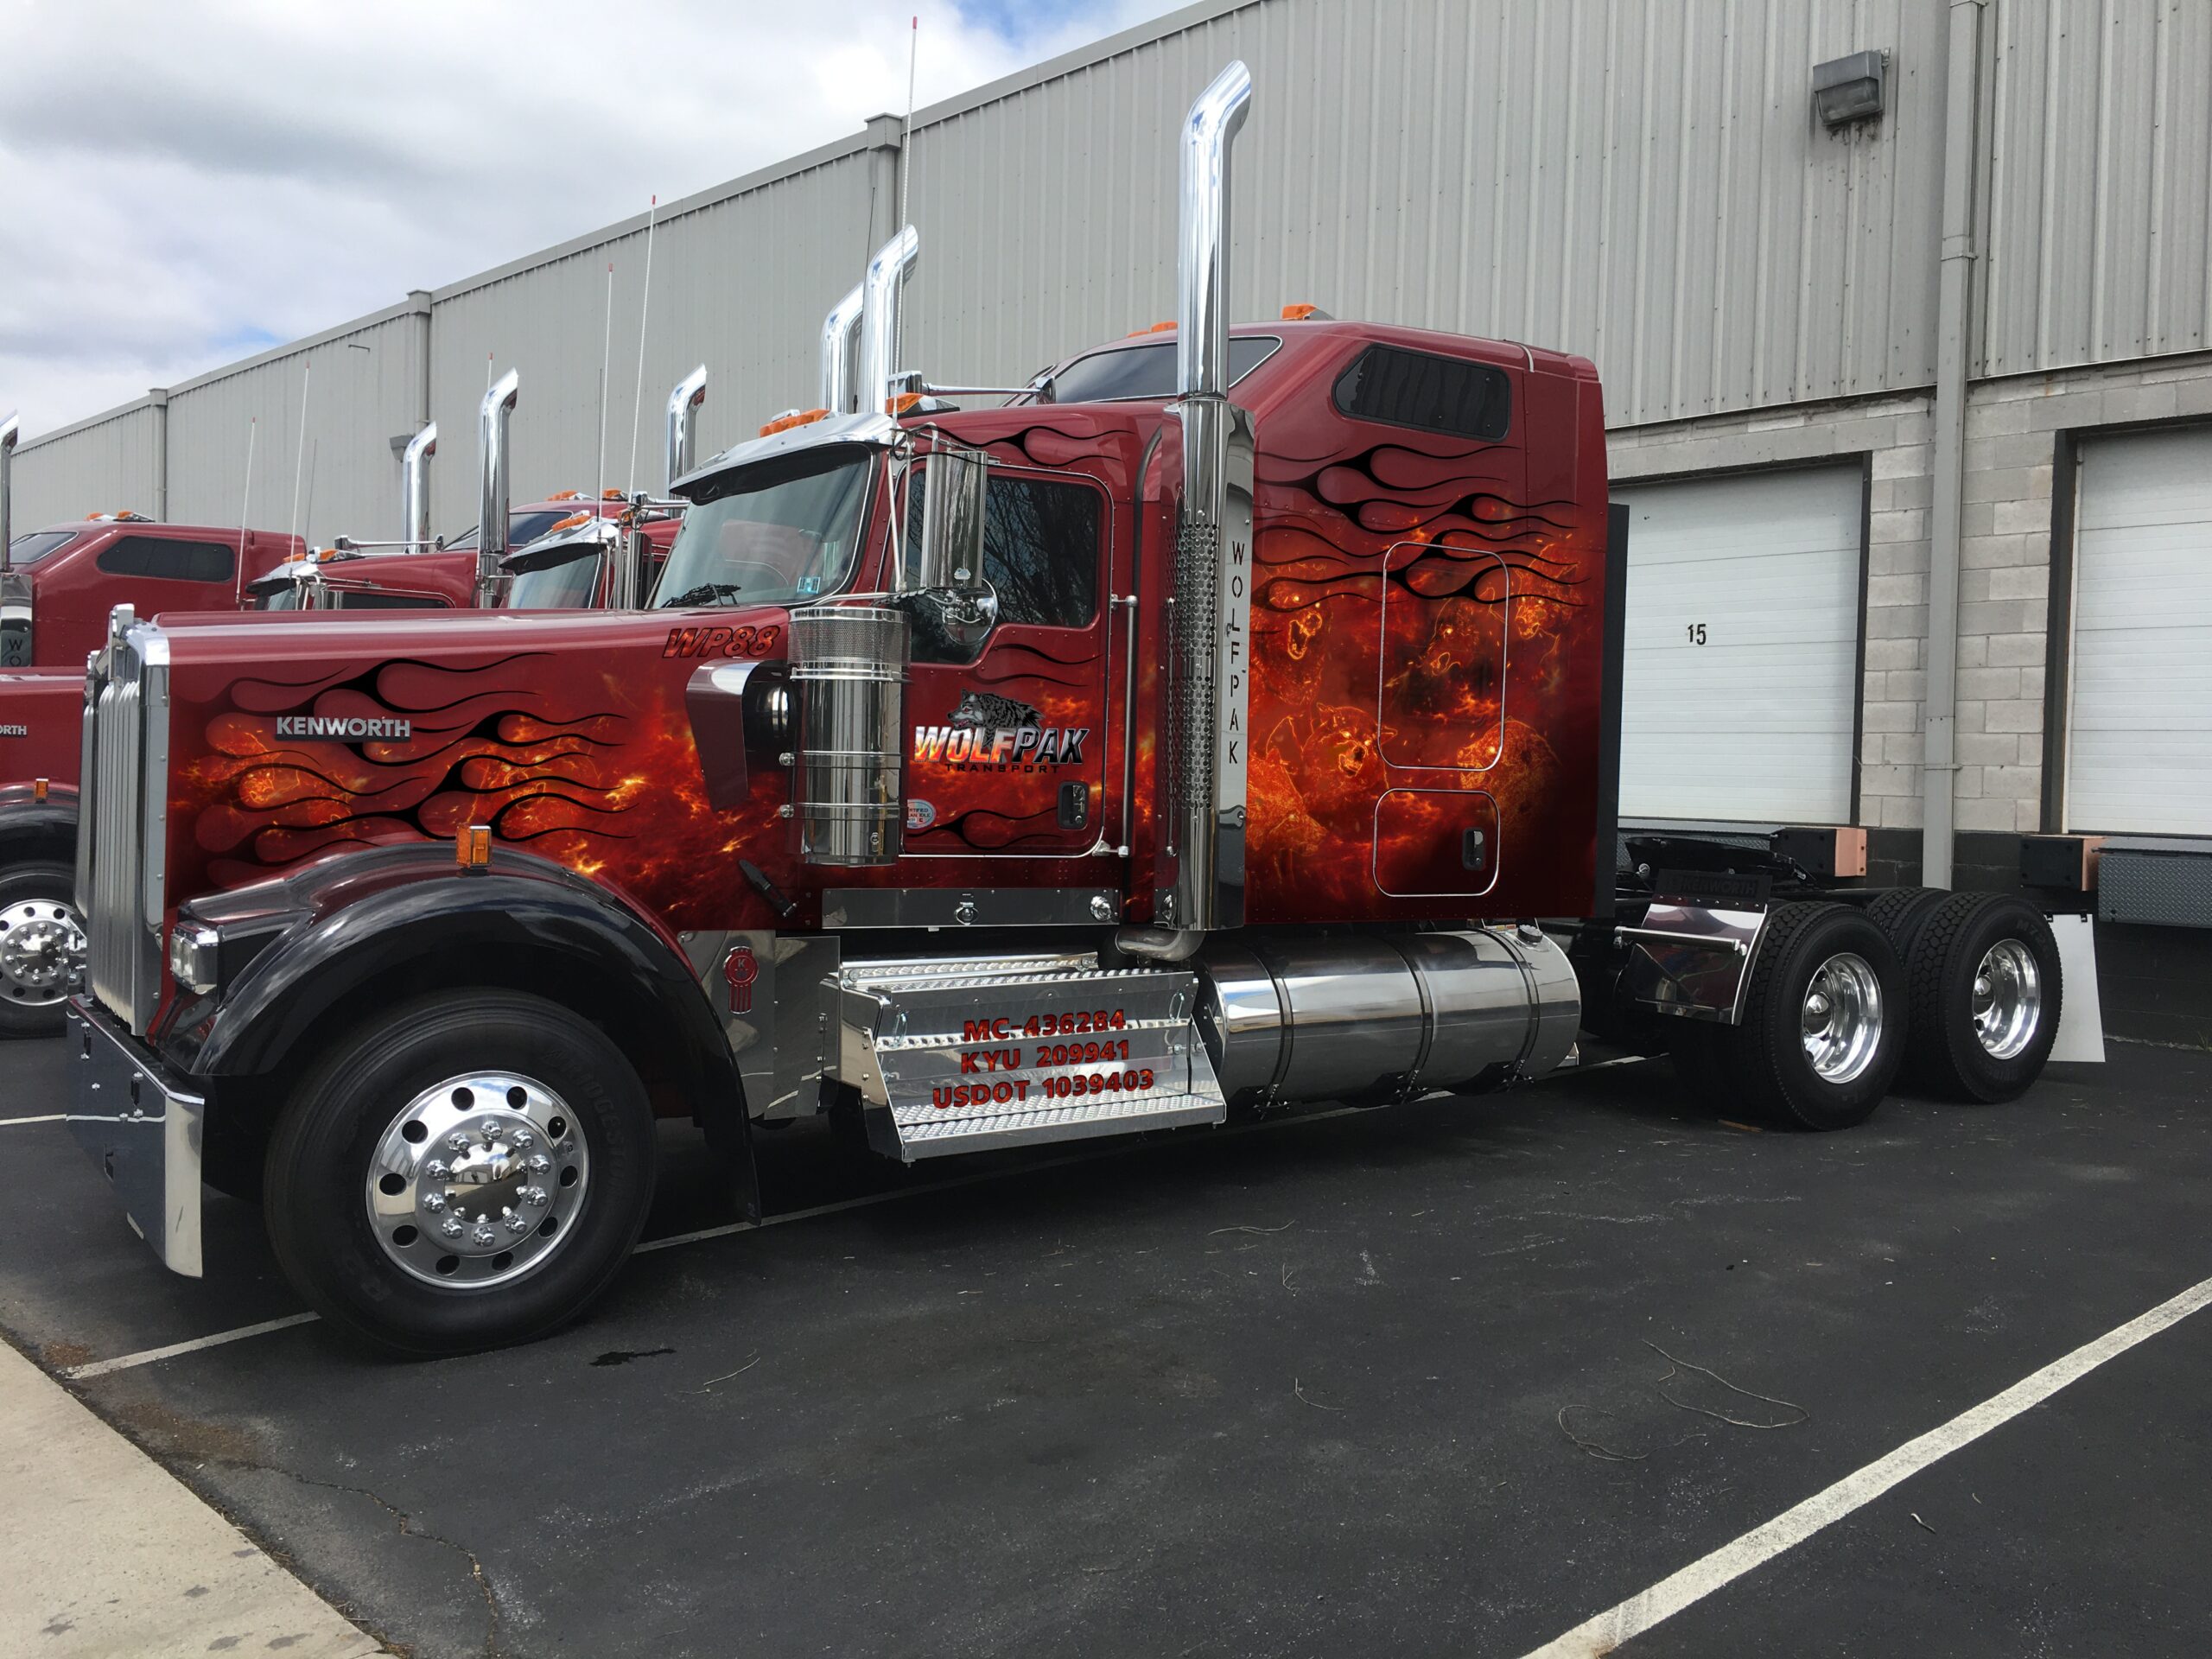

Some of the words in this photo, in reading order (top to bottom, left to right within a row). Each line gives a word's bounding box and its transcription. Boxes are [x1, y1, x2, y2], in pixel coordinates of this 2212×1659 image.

[661, 625, 781, 658] WP88
[1687, 623, 1707, 645] 15
[1228, 539, 1246, 765] WOLFPAK
[276, 716, 410, 737] KENWORTH
[913, 726, 1090, 764] WOLFPAK
[944, 763, 1060, 773] TRANSPORT
[1681, 875, 1758, 896] KENWORTH
[963, 1008, 1126, 1042] MC-436284
[960, 1048, 1021, 1074] KYU
[1036, 1039, 1129, 1068] 209941
[932, 1080, 1031, 1109] USDOT
[1042, 1068, 1154, 1099] 1039403
